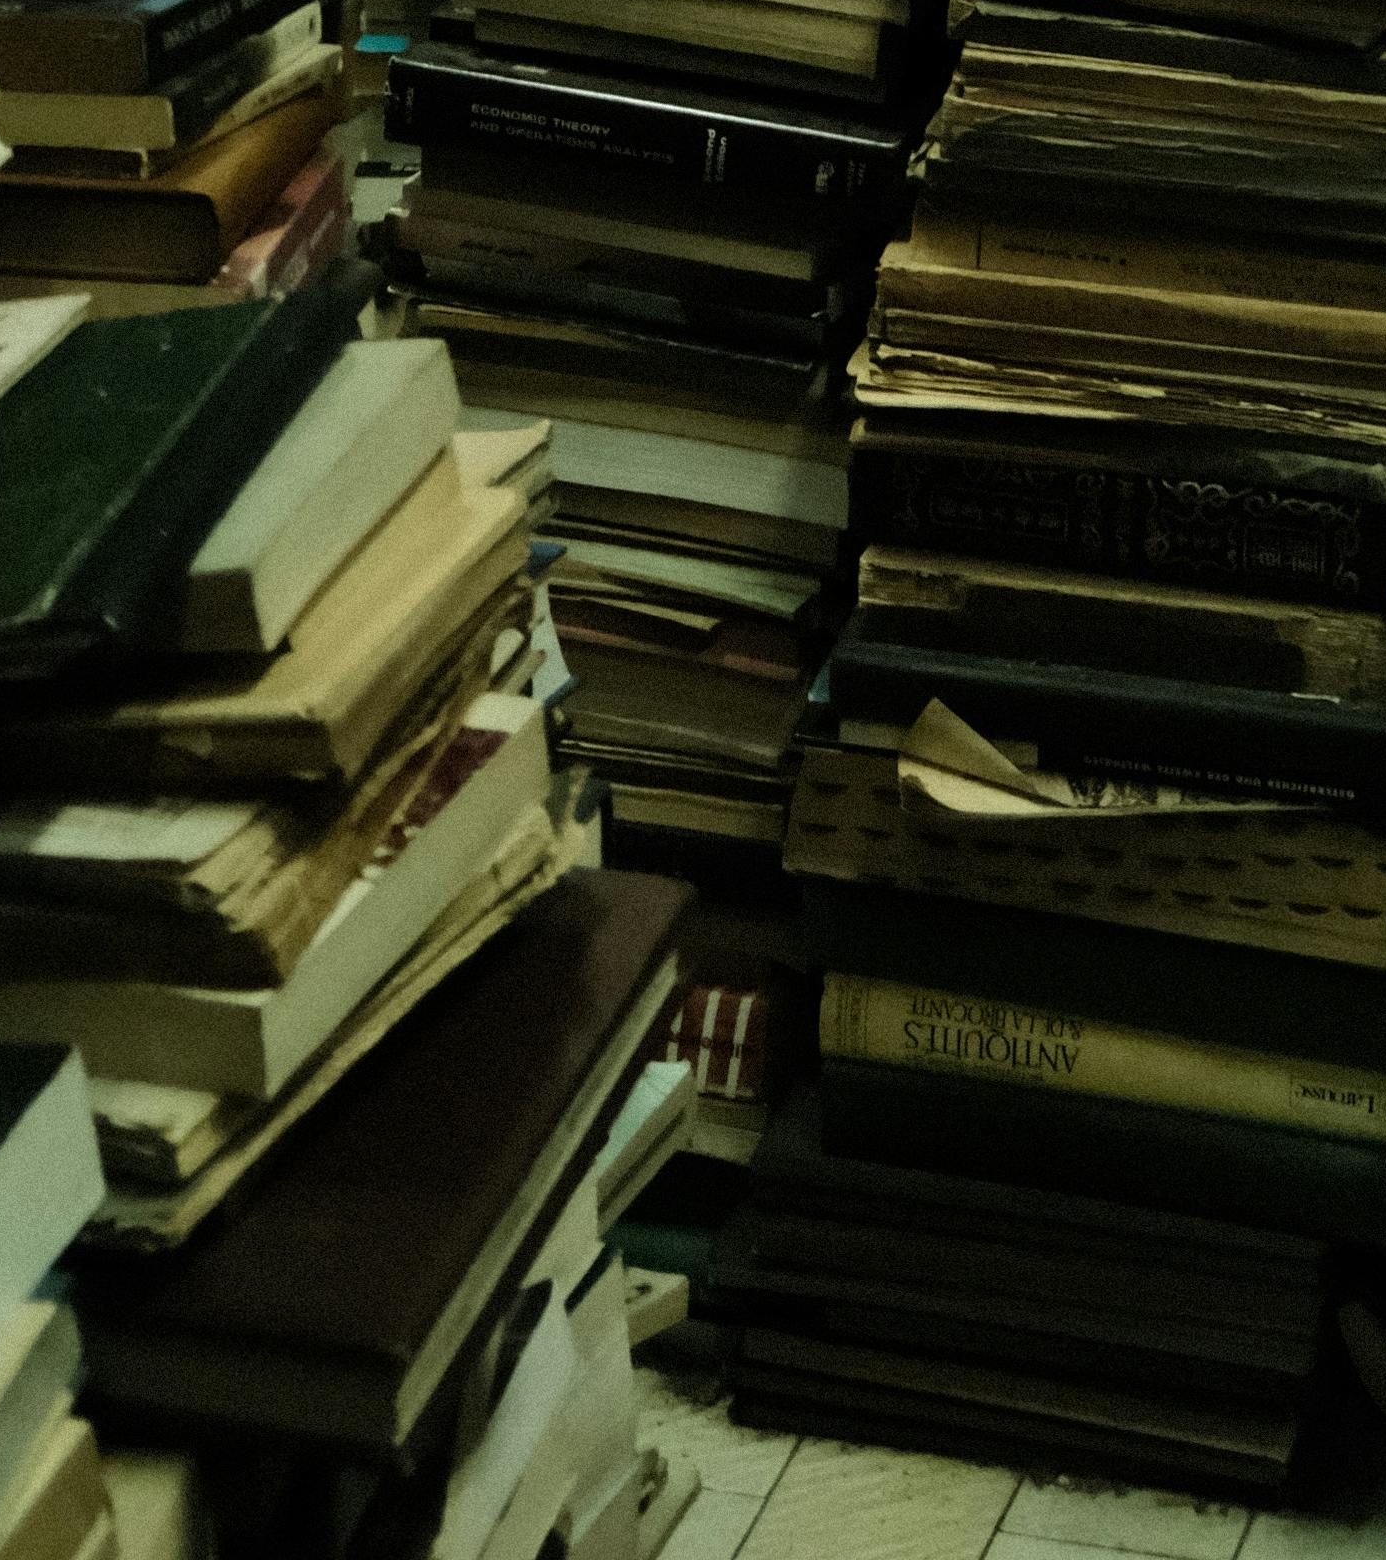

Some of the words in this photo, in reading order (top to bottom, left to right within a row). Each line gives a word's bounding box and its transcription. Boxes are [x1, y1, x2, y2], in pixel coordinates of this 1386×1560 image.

[468, 119, 502, 136] AND
[470, 102, 548, 127] ECONOMIC
[552, 116, 611, 139] THEORY
